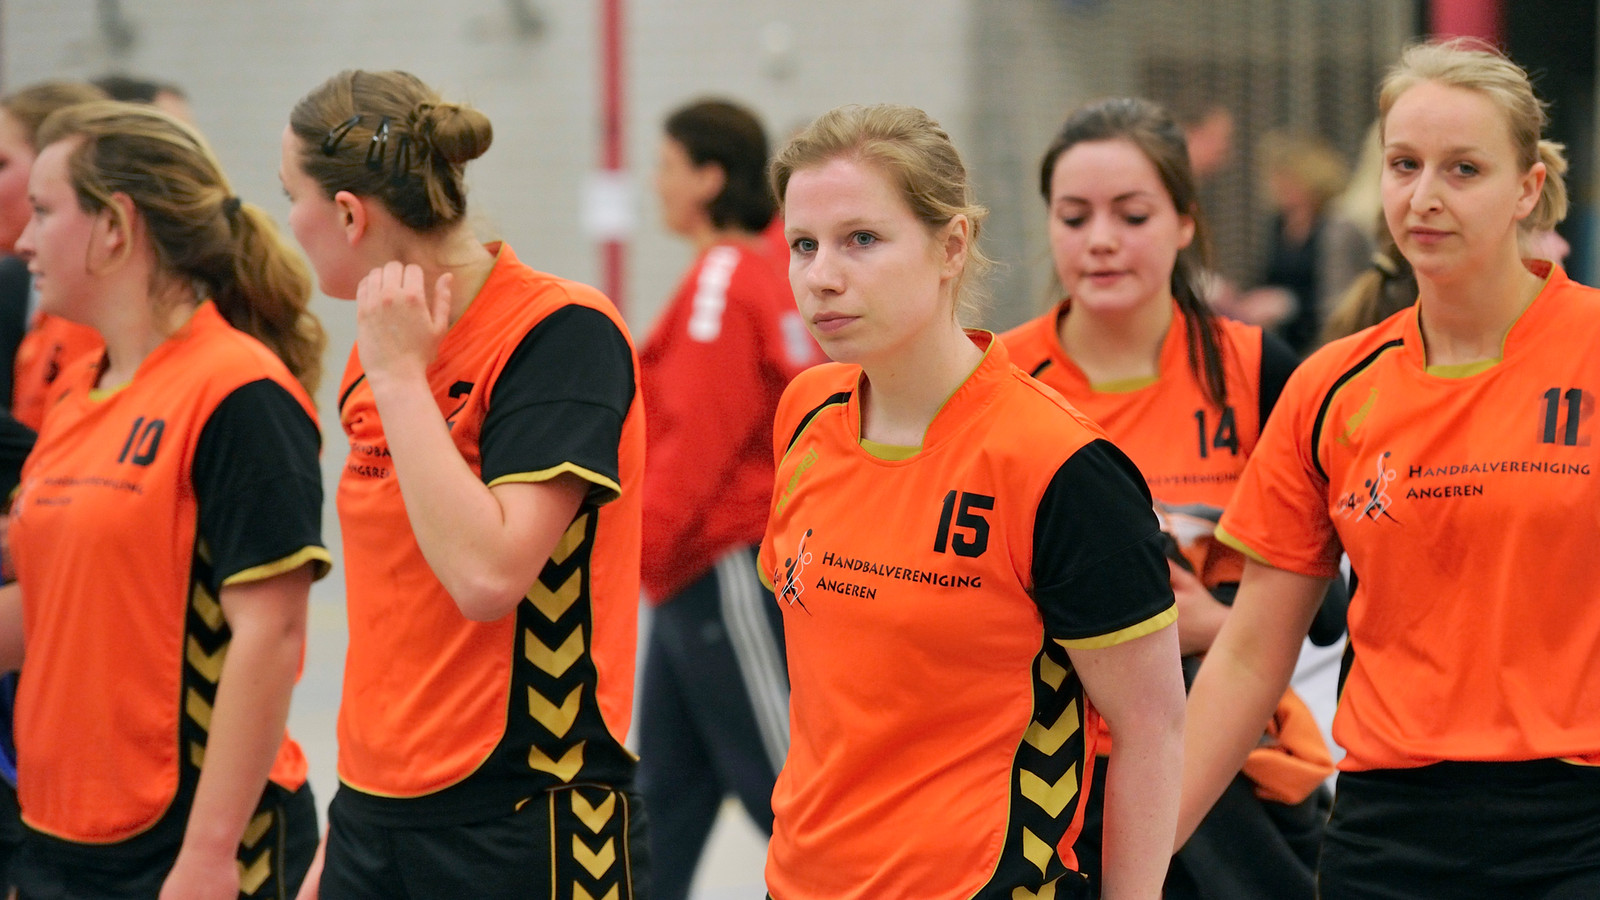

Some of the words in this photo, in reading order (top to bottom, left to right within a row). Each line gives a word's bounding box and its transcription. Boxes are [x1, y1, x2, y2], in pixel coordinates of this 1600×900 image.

[117, 416, 165, 466] 10
[1194, 406, 1239, 458] 14
[1408, 461, 1591, 479] HANDBALVERENIGING
[1406, 484, 1484, 500] ANGEREN
[933, 489, 996, 558] 15
[815, 576, 877, 600] ANGEREN
[821, 551, 982, 588] HANDBALVERENIGING
